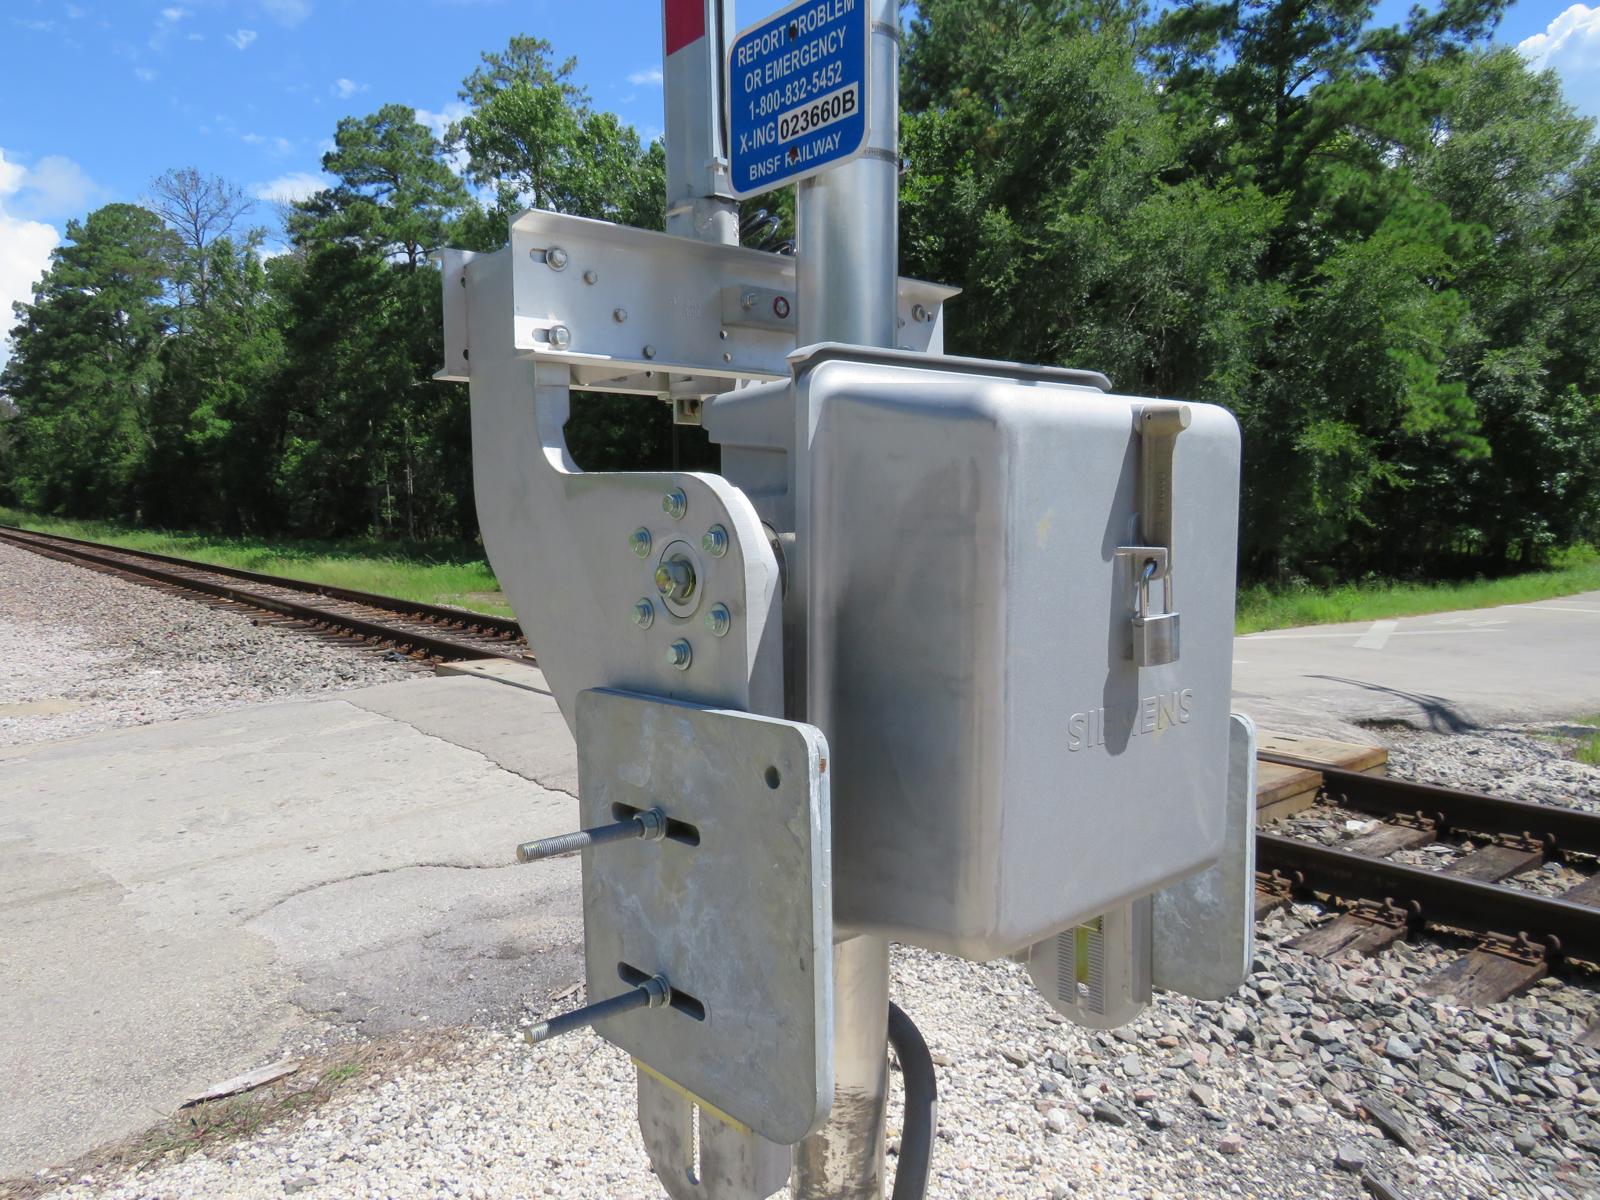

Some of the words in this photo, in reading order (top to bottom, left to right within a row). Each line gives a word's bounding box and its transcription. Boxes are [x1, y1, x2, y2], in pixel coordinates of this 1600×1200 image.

[737, 24, 786, 68] REPORT
[744, 68, 762, 93] OR
[765, 25, 847, 85] EMERGENCY
[749, 60, 843, 120] 1-800-832-5452
[739, 122, 776, 155] X-ING
[780, 89, 856, 140] 023660B
[749, 156, 781, 181] BNSF
[784, 130, 842, 169] RAILWAY
[1068, 688, 1193, 752] SIEENS
